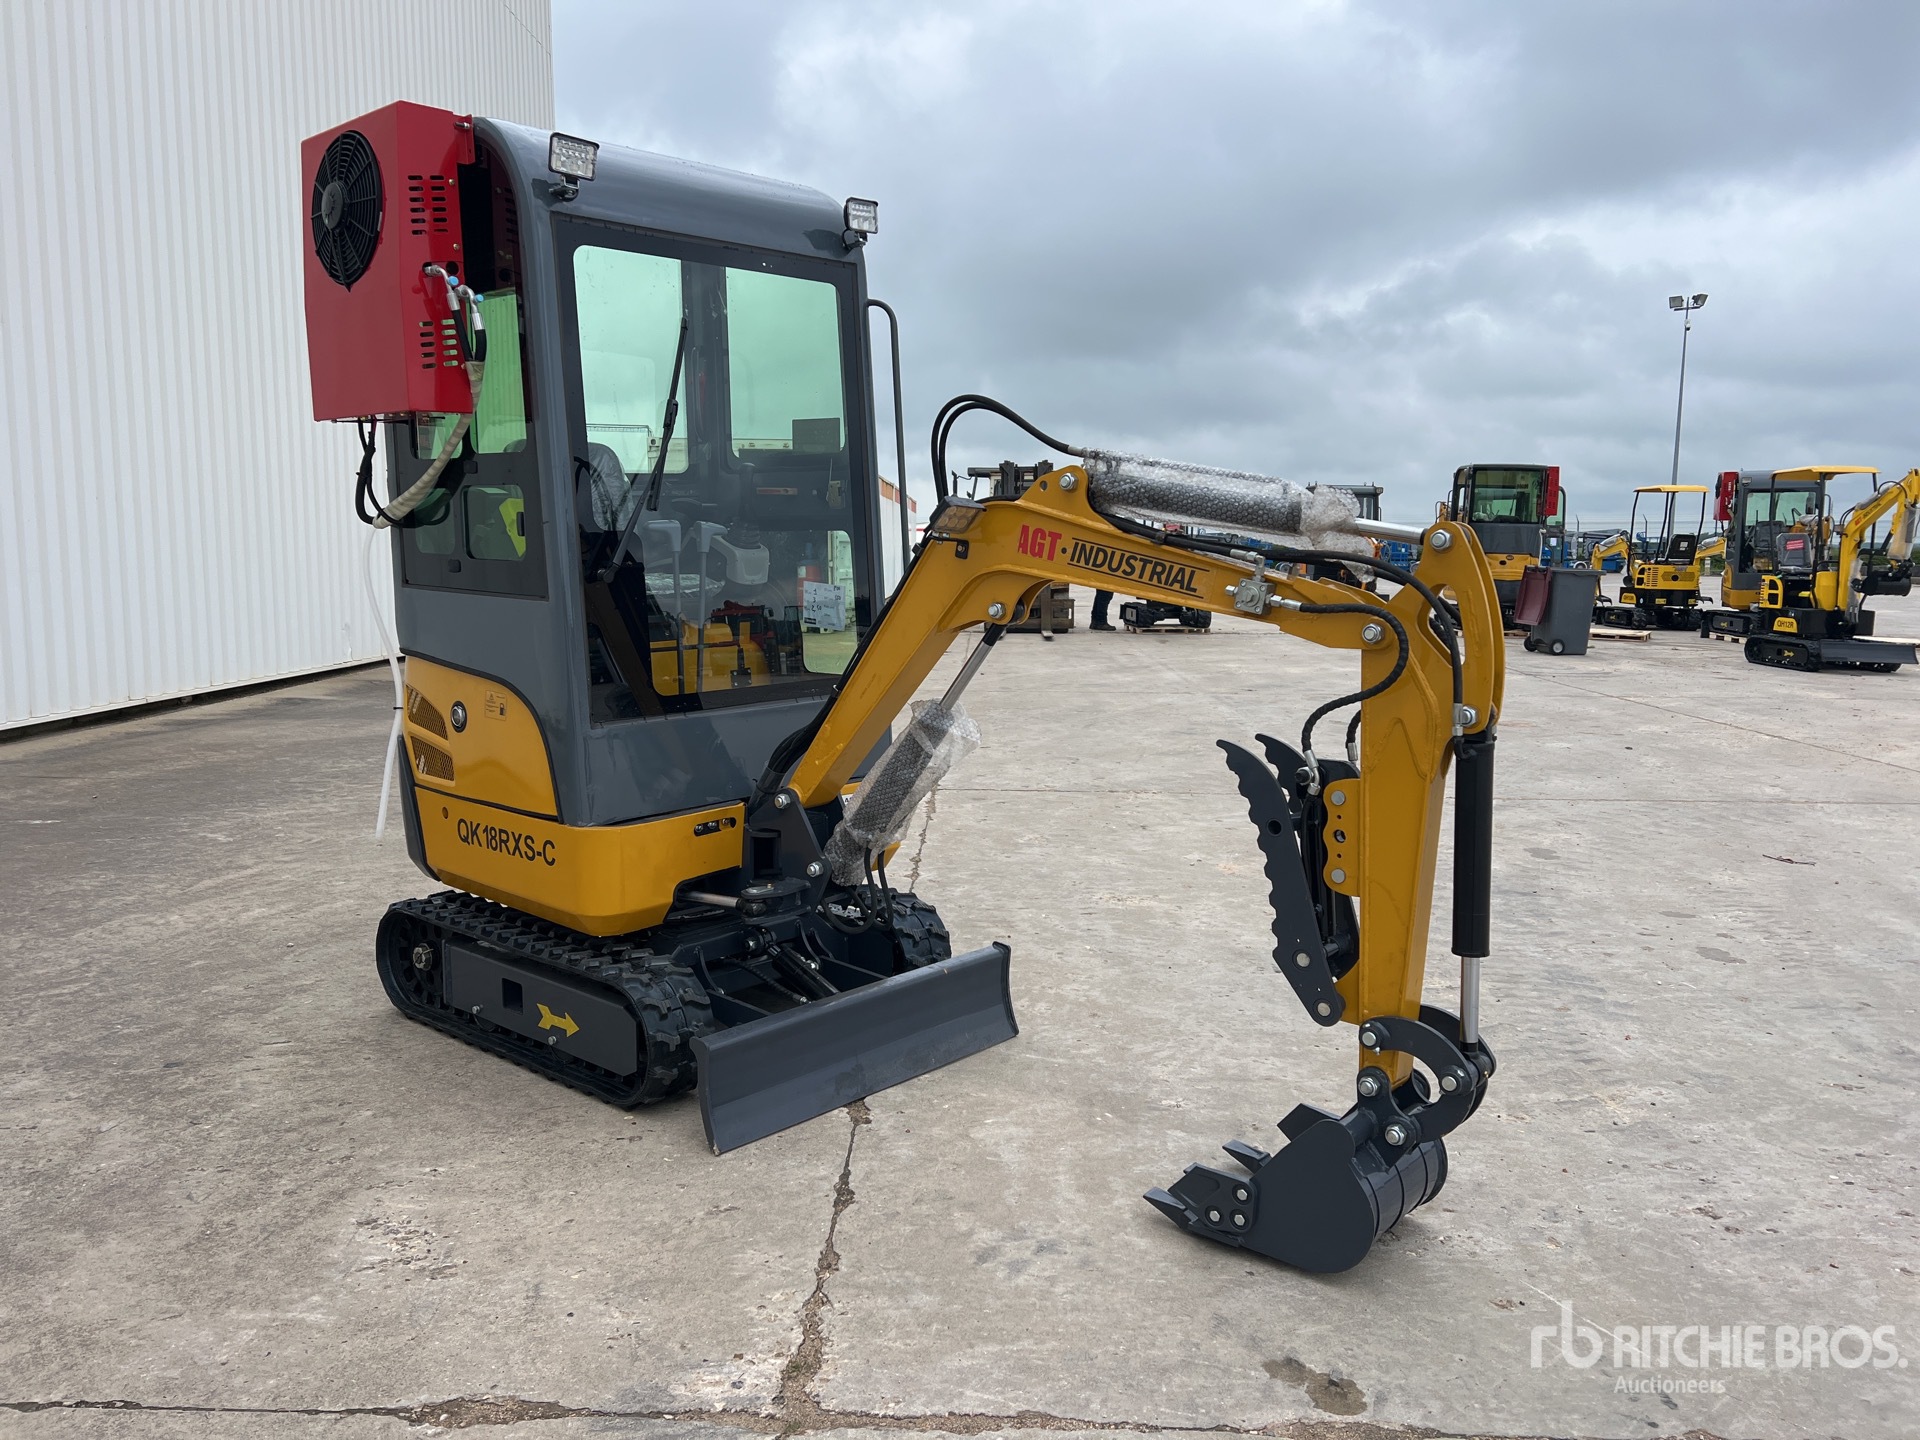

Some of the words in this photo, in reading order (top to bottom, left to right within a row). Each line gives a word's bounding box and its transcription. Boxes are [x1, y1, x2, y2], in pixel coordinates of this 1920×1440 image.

[1017, 524, 1062, 561] AGT
[1069, 541, 1198, 593] INDUSTRIAL
[457, 818, 556, 866] QK18RXS-C
